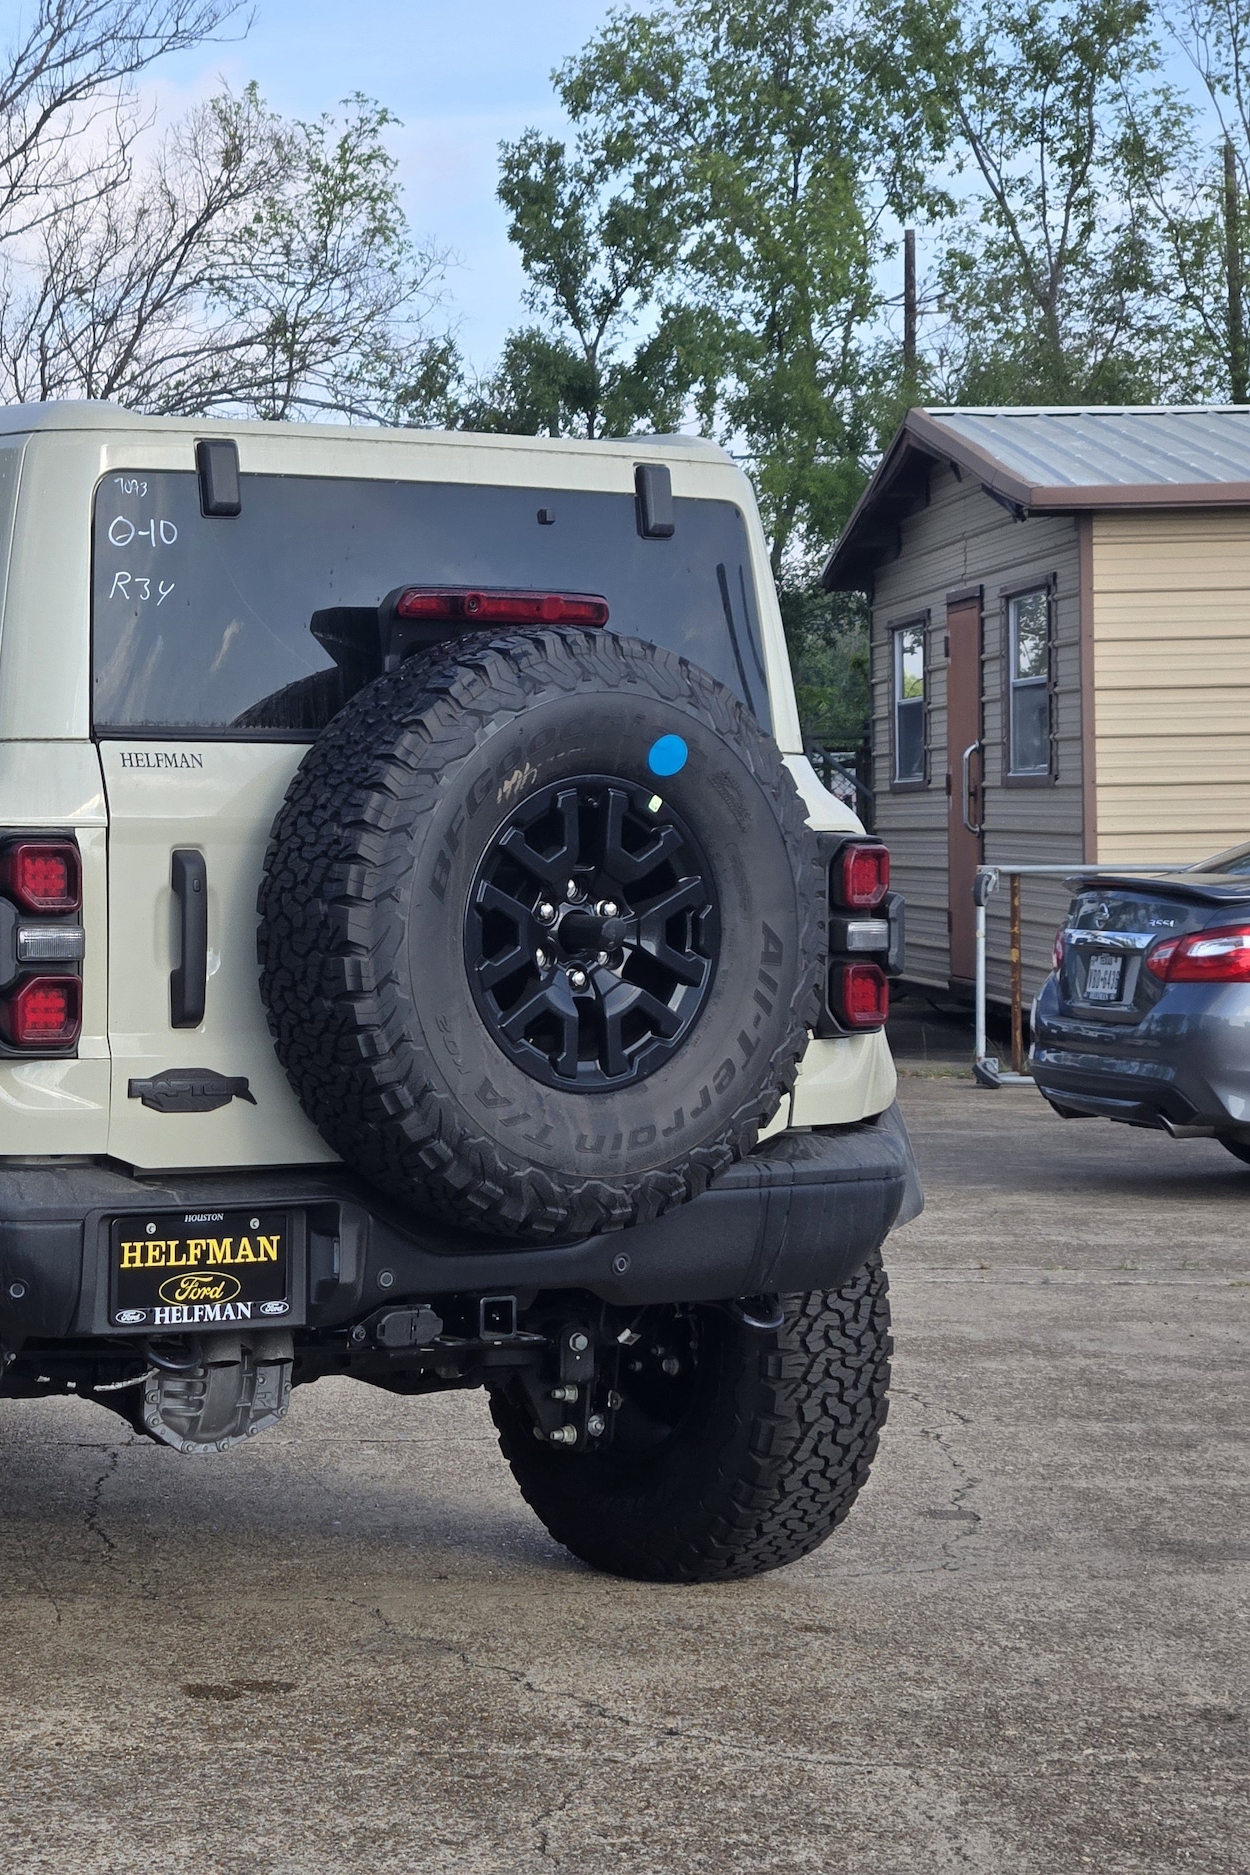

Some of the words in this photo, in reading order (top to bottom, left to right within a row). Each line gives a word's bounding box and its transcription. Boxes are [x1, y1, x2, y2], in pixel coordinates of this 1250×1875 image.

[119, 752, 204, 769] HELFMAN
[575, 920, 784, 1159] All-Terrain
[128, 1076, 257, 1106] RAPTOR
[184, 1213, 224, 1223] HOUSTON
[120, 1235, 281, 1269] HELFMAN
[174, 1276, 226, 1301] Ford
[153, 1302, 252, 1325] HELFMAN
